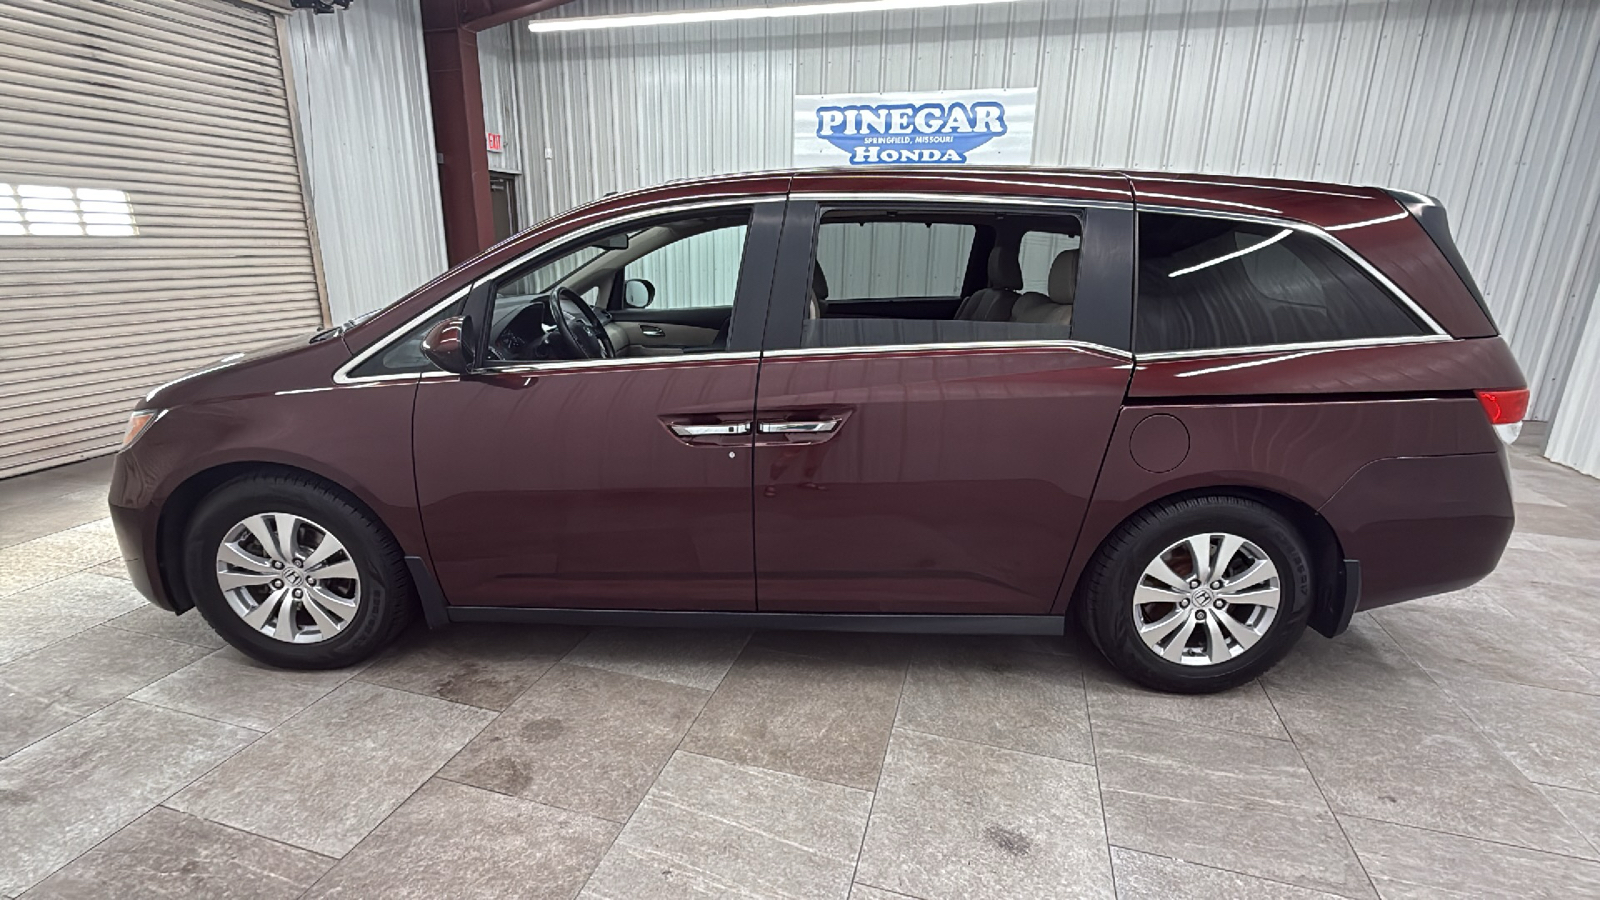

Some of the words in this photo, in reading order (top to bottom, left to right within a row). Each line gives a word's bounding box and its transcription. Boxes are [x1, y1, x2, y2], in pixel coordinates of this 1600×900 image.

[819, 106, 1004, 135] PINEGAR
[488, 133, 501, 149] EXIT
[864, 136, 913, 145] SPRINGFIELD,
[914, 136, 954, 144] MISSOURI
